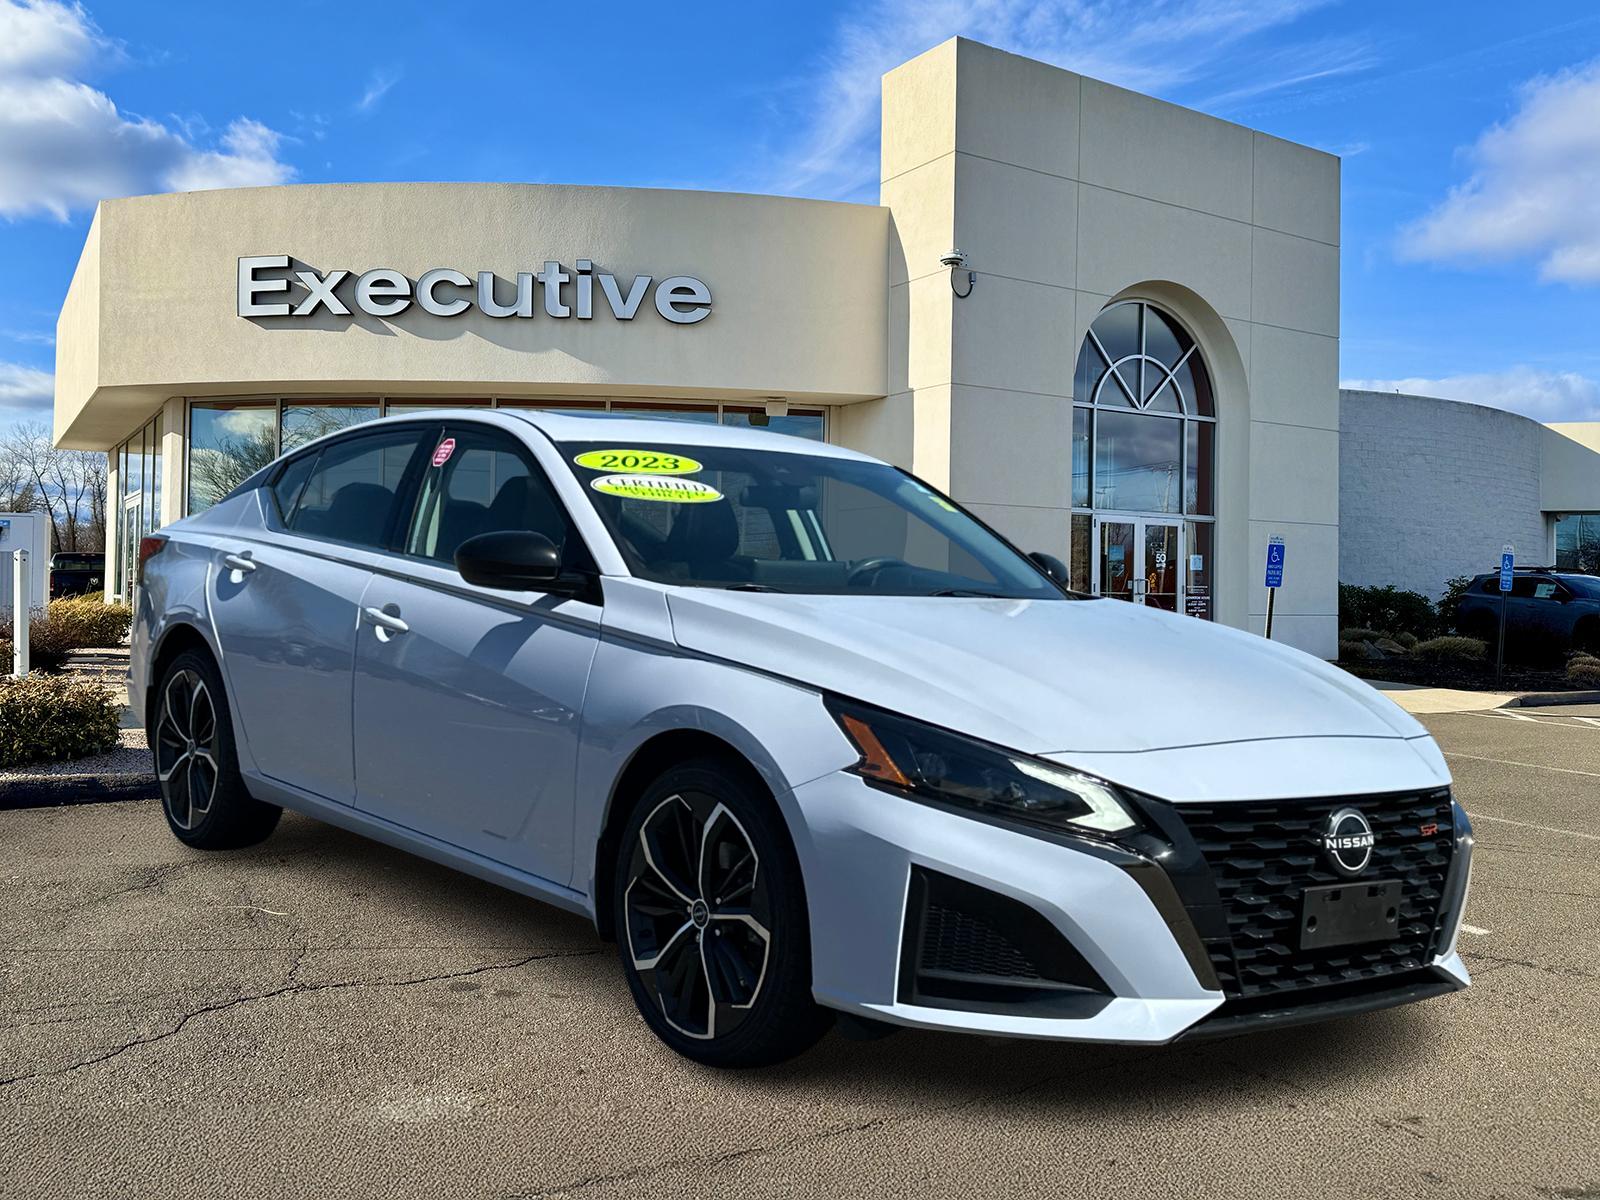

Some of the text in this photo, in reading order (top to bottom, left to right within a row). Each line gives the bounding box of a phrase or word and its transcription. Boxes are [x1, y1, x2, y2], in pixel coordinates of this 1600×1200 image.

[237, 255, 713, 325] Executive
[601, 455, 680, 470] 2023
[606, 478, 708, 493] CERTIFIED
[1420, 823, 1438, 837] SR
[1325, 835, 1374, 849] NISSAN
